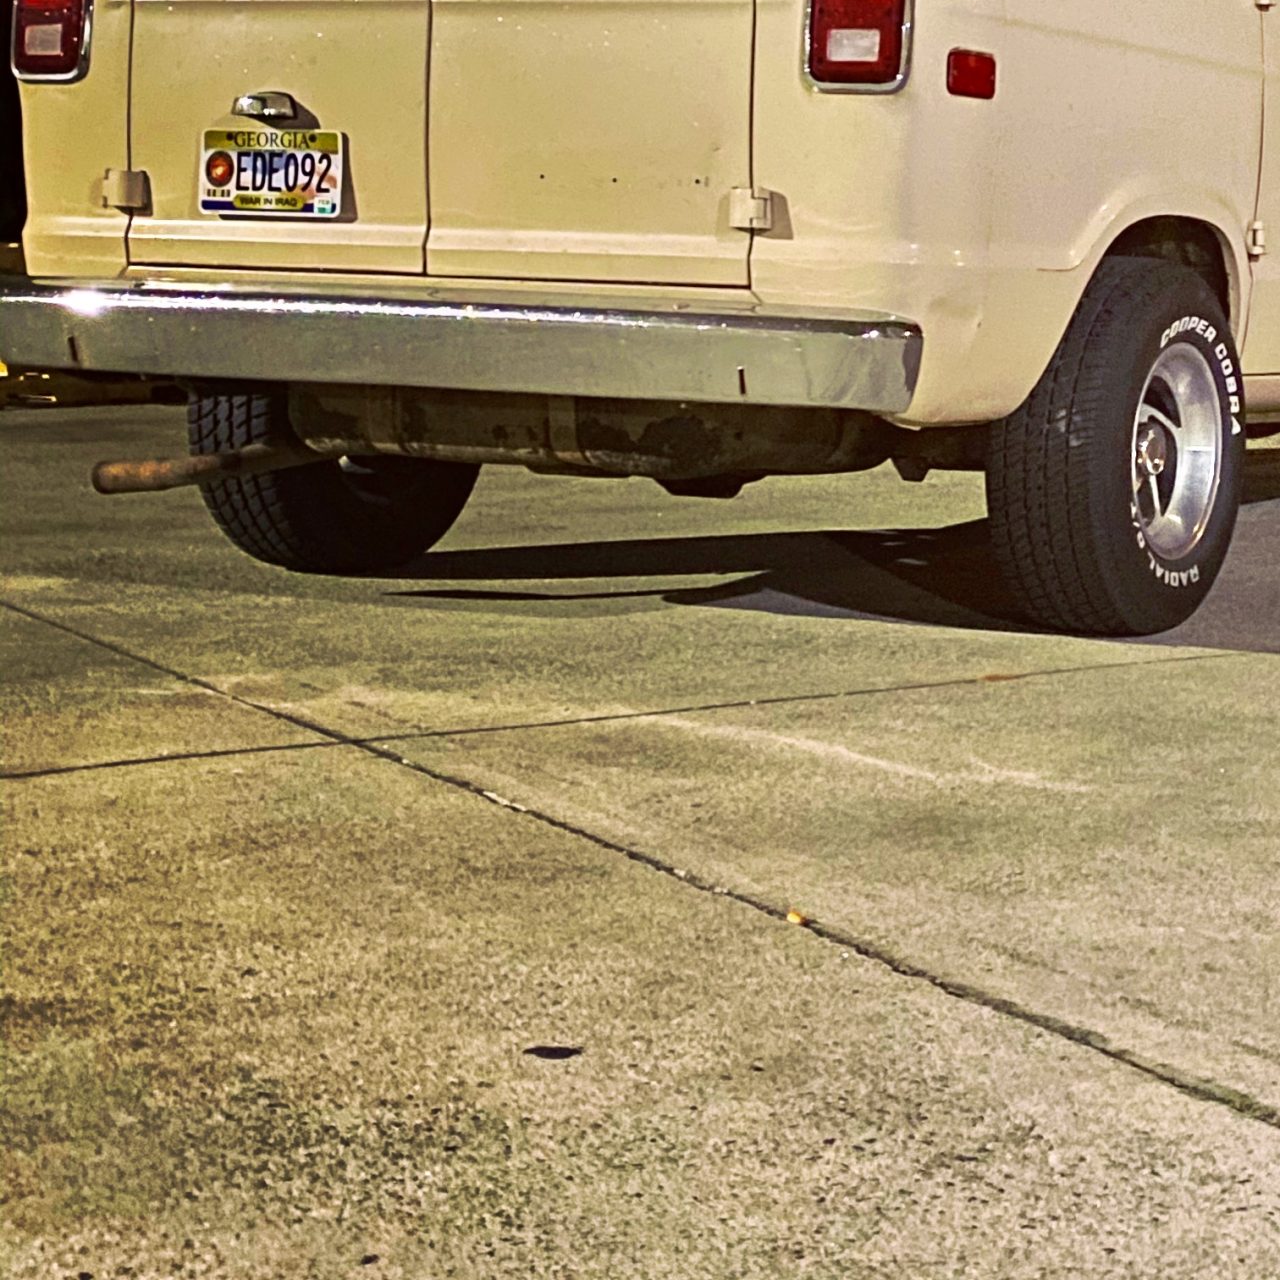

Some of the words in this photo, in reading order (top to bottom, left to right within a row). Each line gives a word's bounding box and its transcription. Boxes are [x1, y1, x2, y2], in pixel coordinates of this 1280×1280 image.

[233, 130, 312, 149] GEORGIA
[235, 151, 332, 193] EDE092
[240, 196, 261, 206] WAR
[263, 197, 273, 206] IN
[275, 198, 298, 207] IRAQ
[1160, 316, 1217, 348] COOPER
[1214, 342, 1241, 435] COBRA
[1147, 551, 1200, 587] RADIAL
